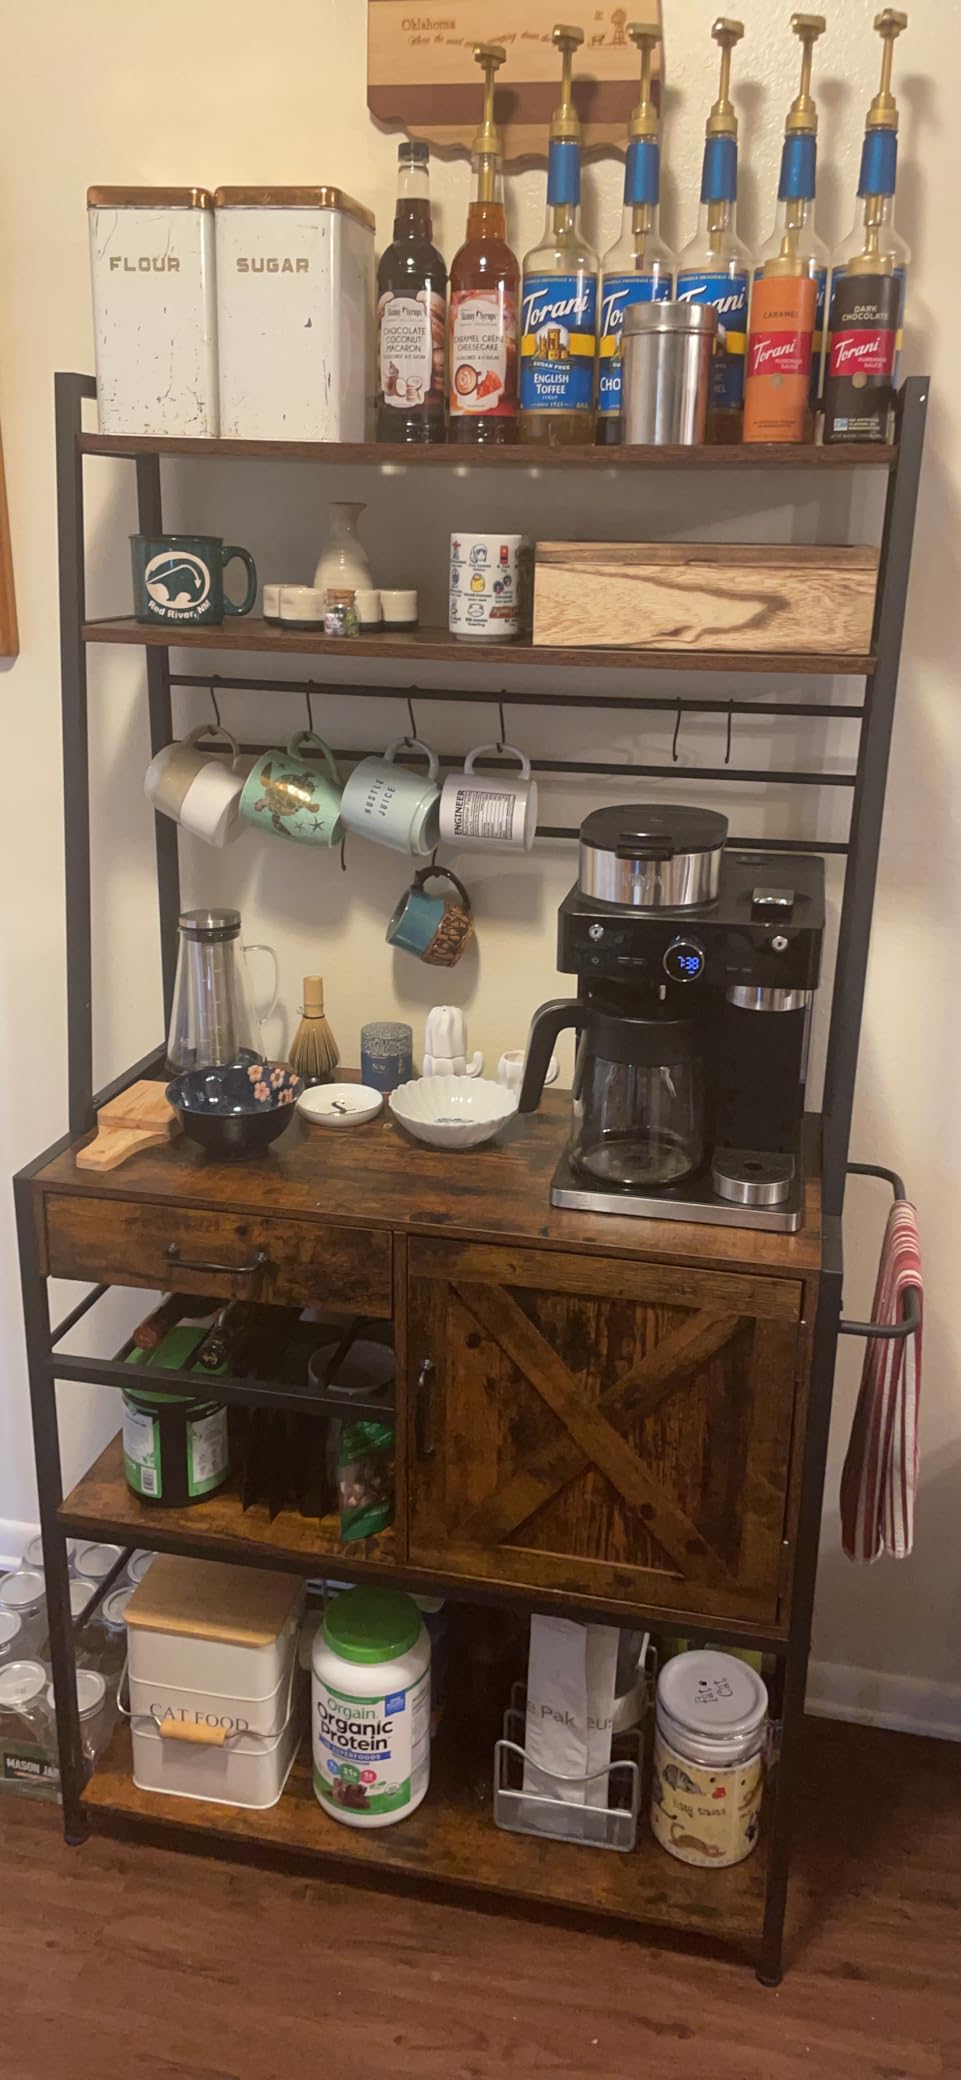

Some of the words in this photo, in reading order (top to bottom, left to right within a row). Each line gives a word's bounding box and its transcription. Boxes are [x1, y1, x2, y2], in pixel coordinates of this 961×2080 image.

[401, 18, 456, 31] Oklahoma
[109, 256, 181, 273] FLOUR
[236, 257, 310, 273] SUGAR
[523, 287, 590, 336] Torani
[762, 310, 800, 319] CARAMEL
[841, 311, 889, 321] CHOCOLATE
[854, 305, 878, 313] DARK
[383, 327, 426, 336] CHOCOLATE
[386, 335, 421, 344] COCONUT
[386, 344, 422, 353] MACARON
[753, 338, 797, 370] Torani
[835, 336, 880, 369] Torani
[533, 373, 569, 384] ENGLISH
[536, 383, 567, 394] TOFFEE
[148, 599, 166, 616] Red
[197, 599, 211, 614] NM
[364, 777, 385, 815] HUSTLE
[377, 784, 397, 817] JUICE
[454, 789, 466, 835] ENGINEER
[677, 955, 700, 970] 7:38
[150, 1702, 188, 1721] CAT
[195, 1710, 249, 1732] FOOD
[327, 1698, 376, 1719] Orgain
[317, 1701, 394, 1737] Organic
[320, 1721, 388, 1751] Protein
[6, 1757, 41, 1774] MASON
